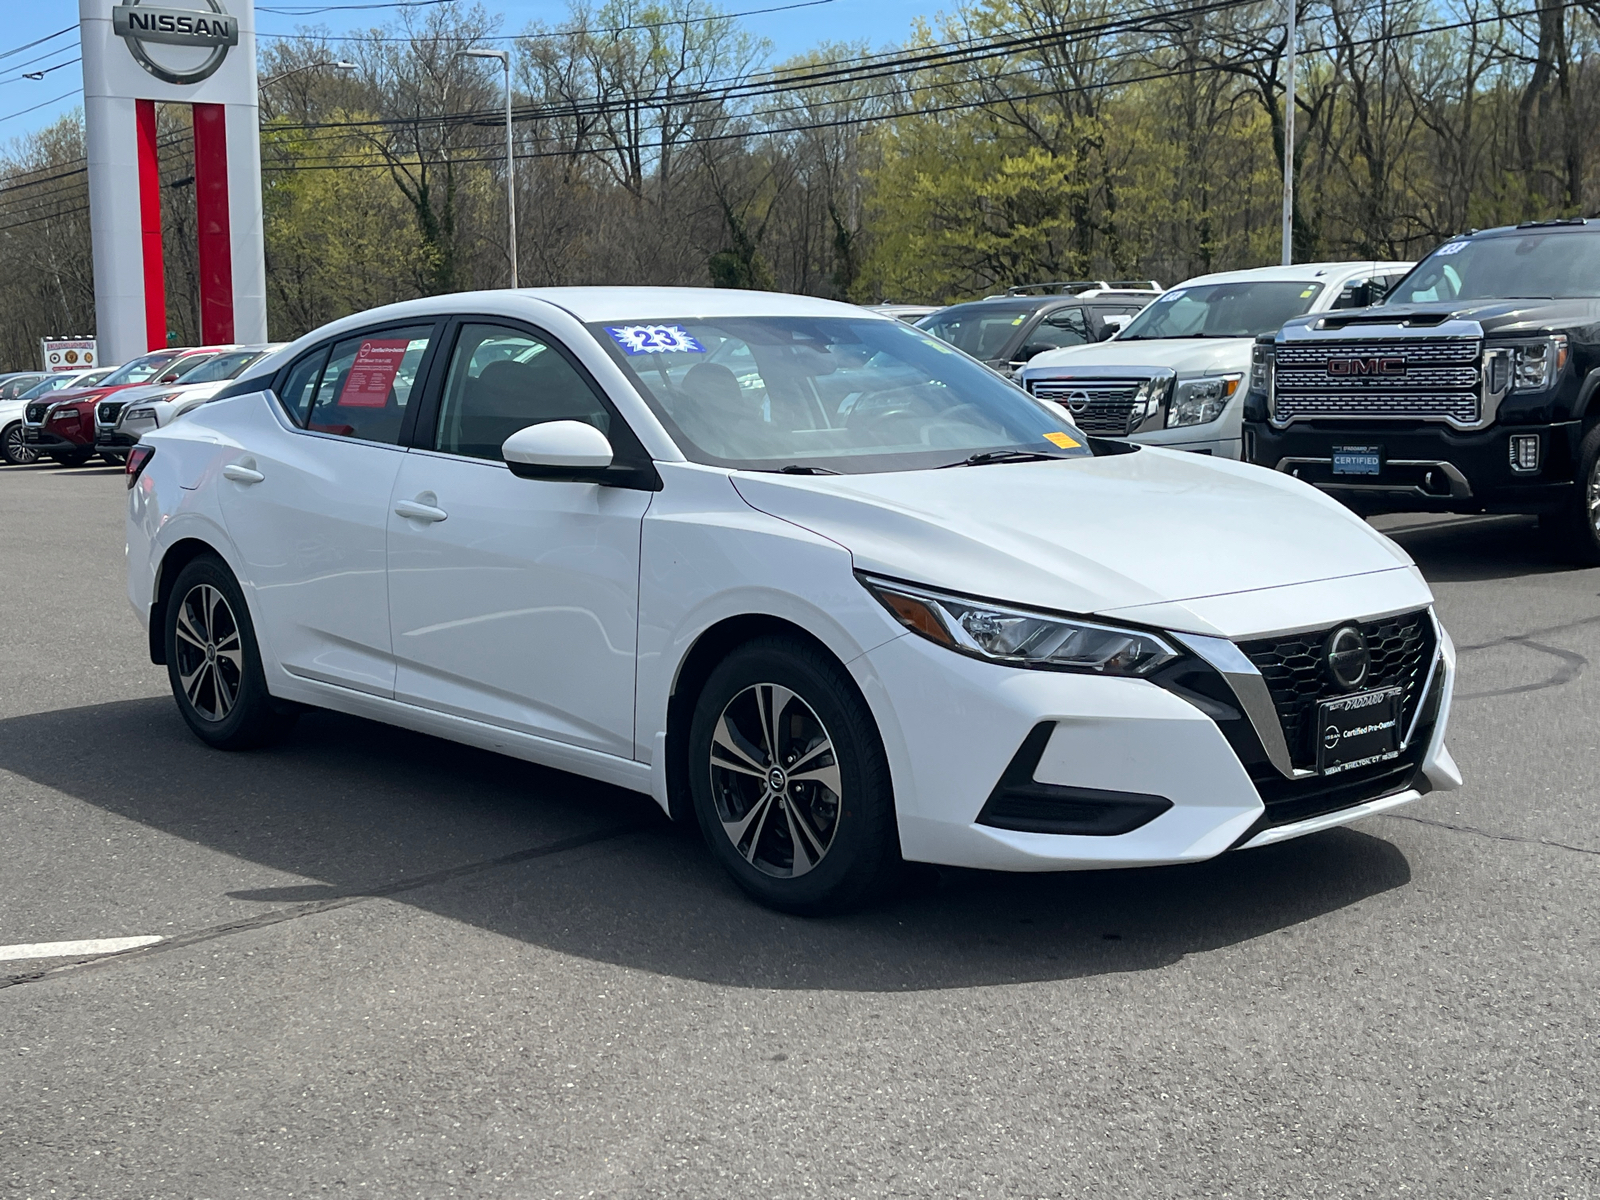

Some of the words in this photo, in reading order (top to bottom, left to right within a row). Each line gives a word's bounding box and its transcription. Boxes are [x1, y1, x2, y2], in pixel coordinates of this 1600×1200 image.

[128, 12, 229, 37] NISSAN
[633, 330, 678, 347] 23
[1328, 358, 1405, 375] GMC
[1334, 456, 1379, 465] CERTIFIED
[1343, 726, 1368, 738] Certified
[1368, 718, 1396, 733] Pre-Owned
